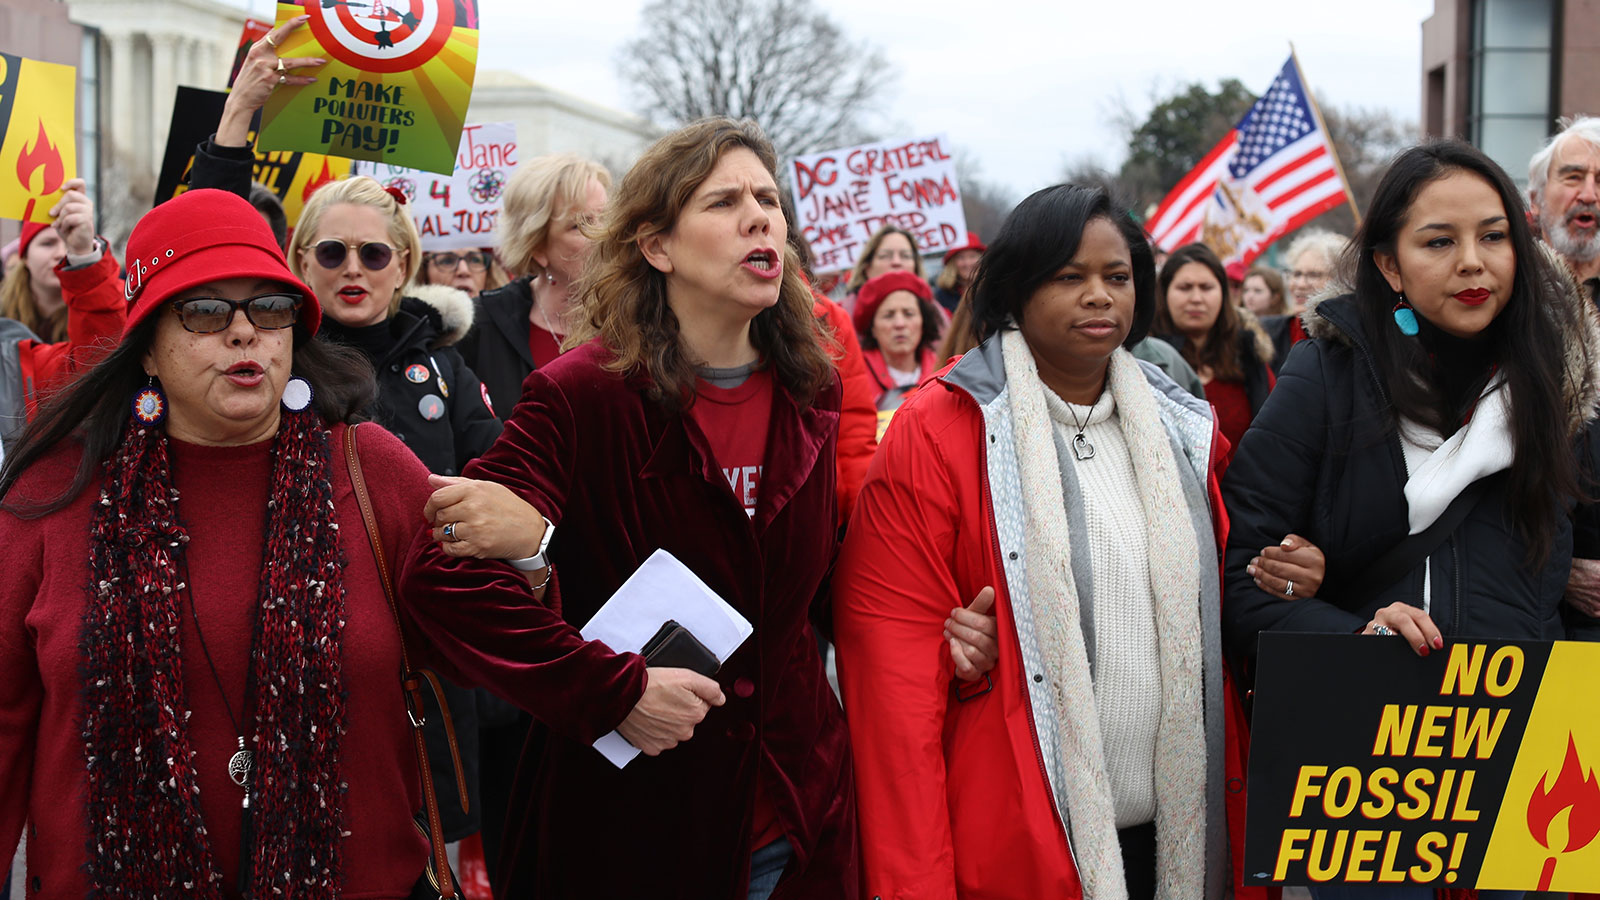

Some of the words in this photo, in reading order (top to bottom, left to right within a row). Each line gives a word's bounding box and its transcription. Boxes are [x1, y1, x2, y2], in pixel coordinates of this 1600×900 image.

[313, 97, 415, 127] POLLUTERS
[328, 76, 407, 106] MAKE
[321, 118, 400, 154] PAY!
[459, 125, 518, 170] Jane
[429, 180, 450, 208] 4
[806, 179, 871, 223] JANE
[883, 173, 957, 209] FONDA
[801, 222, 851, 246] CAME
[1439, 642, 1526, 698] NO
[1371, 703, 1512, 760] NEW
[1288, 764, 1481, 823] FOSSIL
[1271, 828, 1469, 884] FUELS!
